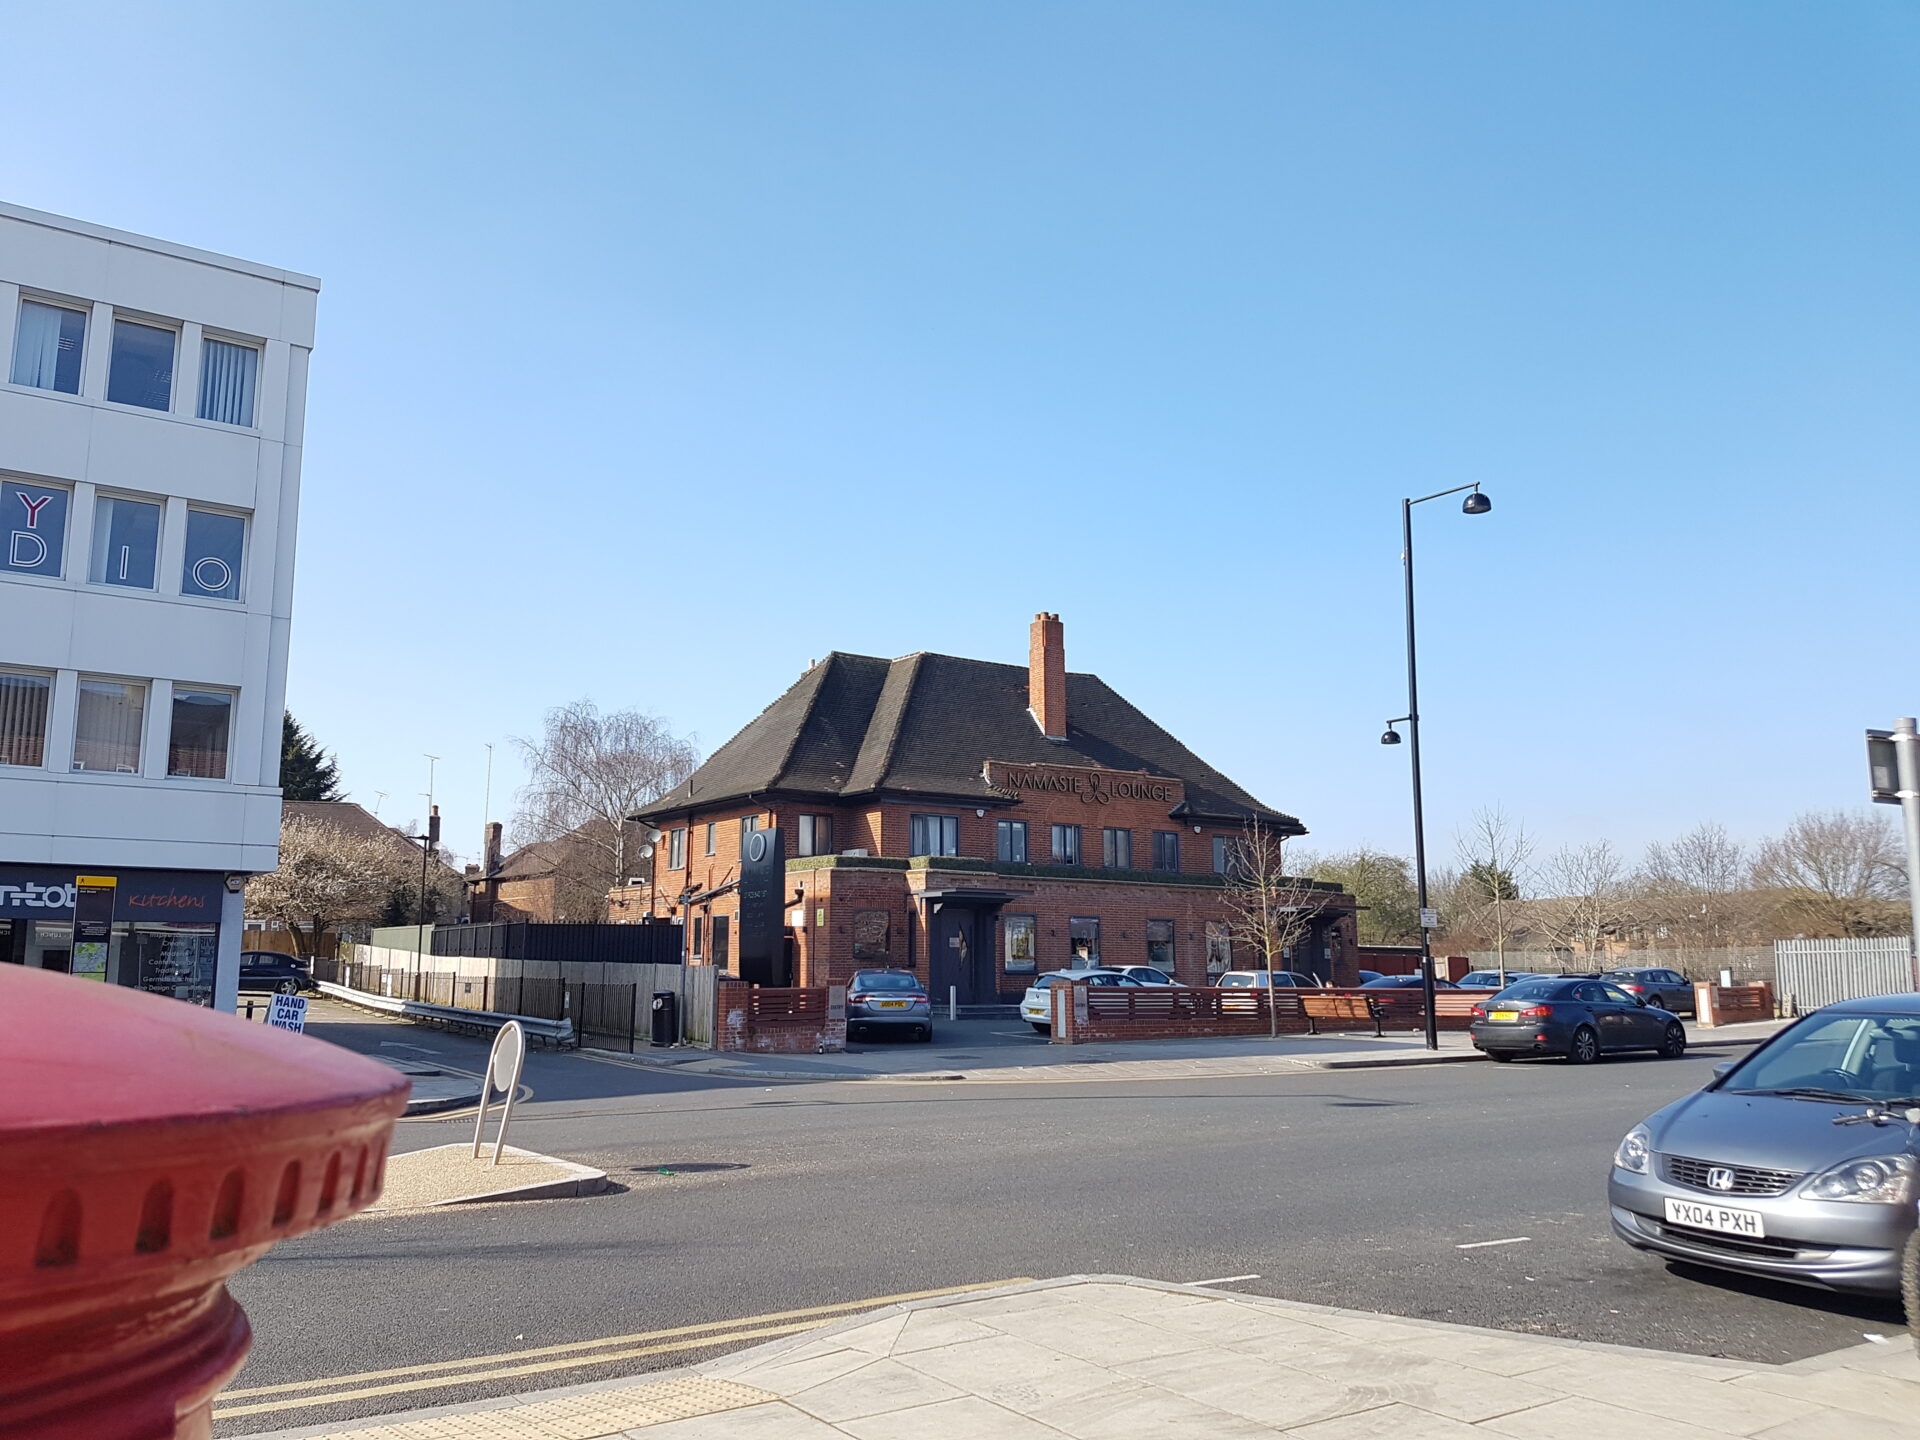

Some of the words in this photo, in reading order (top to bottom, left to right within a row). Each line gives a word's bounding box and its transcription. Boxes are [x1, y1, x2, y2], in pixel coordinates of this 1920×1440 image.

[1008, 771, 1082, 793] NAMASTE
[1110, 780, 1172, 801] LOUNGE
[275, 995, 305, 1009] HAND
[277, 1008, 299, 1021] CAR
[272, 1019, 302, 1033] WASH
[1672, 1203, 1714, 1226] YX04
[1719, 1211, 1756, 1233] PXH
